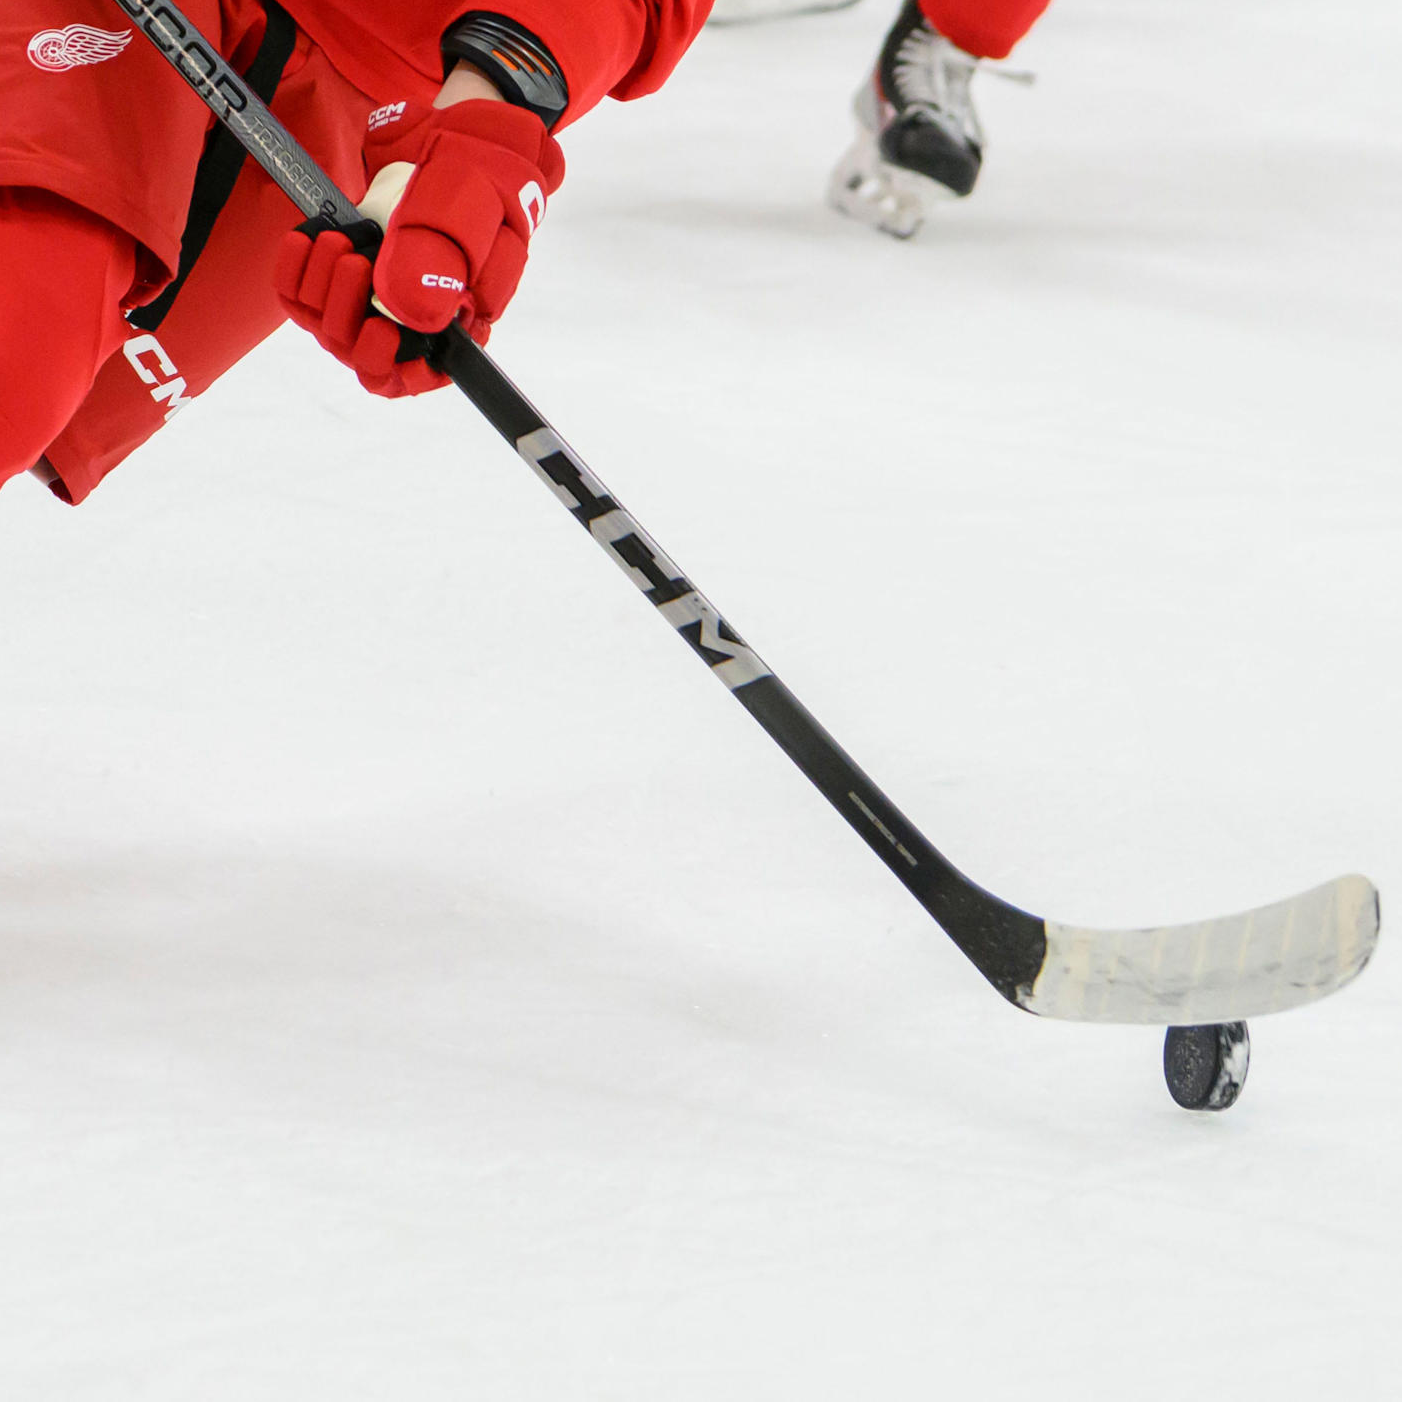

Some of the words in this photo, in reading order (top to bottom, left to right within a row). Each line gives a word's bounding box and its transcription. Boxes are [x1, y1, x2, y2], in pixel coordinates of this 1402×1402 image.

[248, 116, 323, 204] TRIGGER
[368, 101, 407, 125] CCM
[123, 309, 192, 422] CM
[516, 426, 774, 691] CCM
